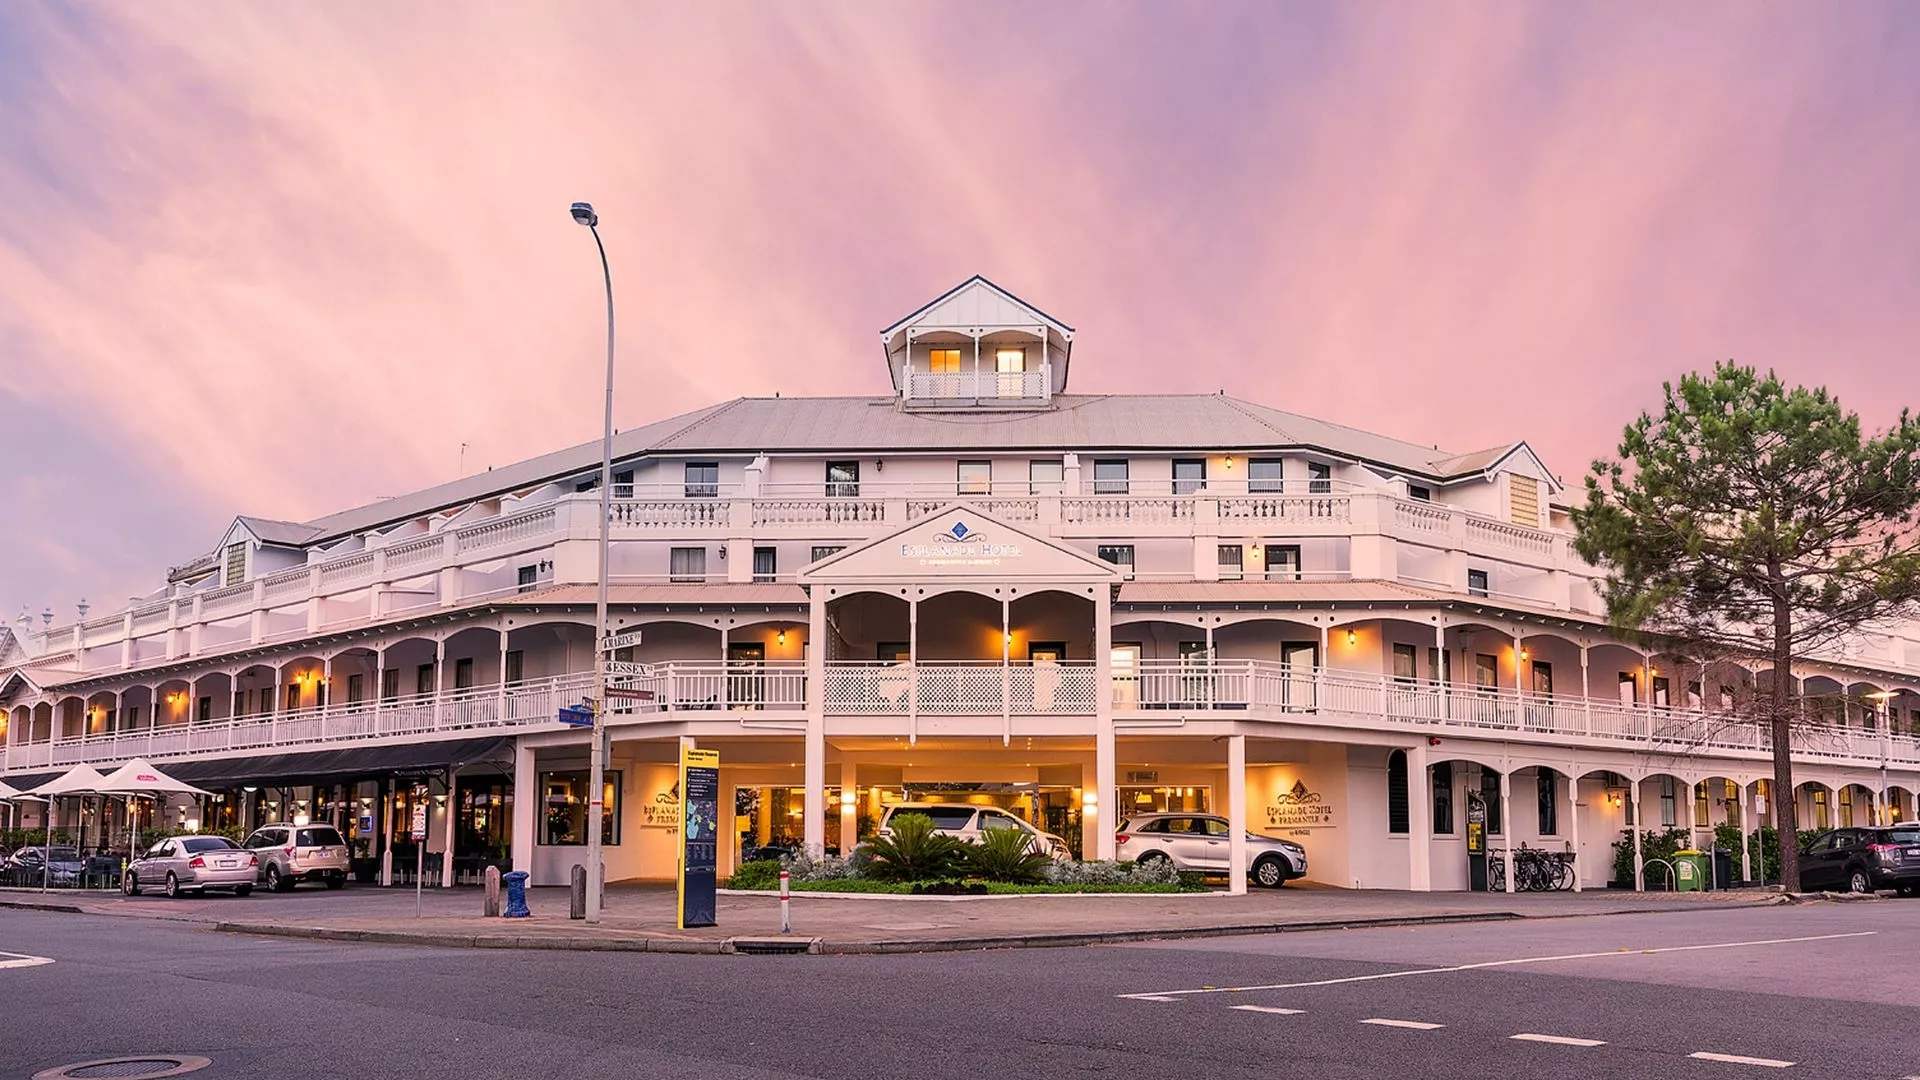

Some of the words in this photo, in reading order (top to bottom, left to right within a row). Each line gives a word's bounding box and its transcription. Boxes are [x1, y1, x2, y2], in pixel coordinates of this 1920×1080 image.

[901, 544, 975, 556] ESPLANADE
[982, 544, 1022, 556] HOTEL
[613, 662, 646, 675] ESSEX
[1267, 806, 1308, 816] ESPLANADE
